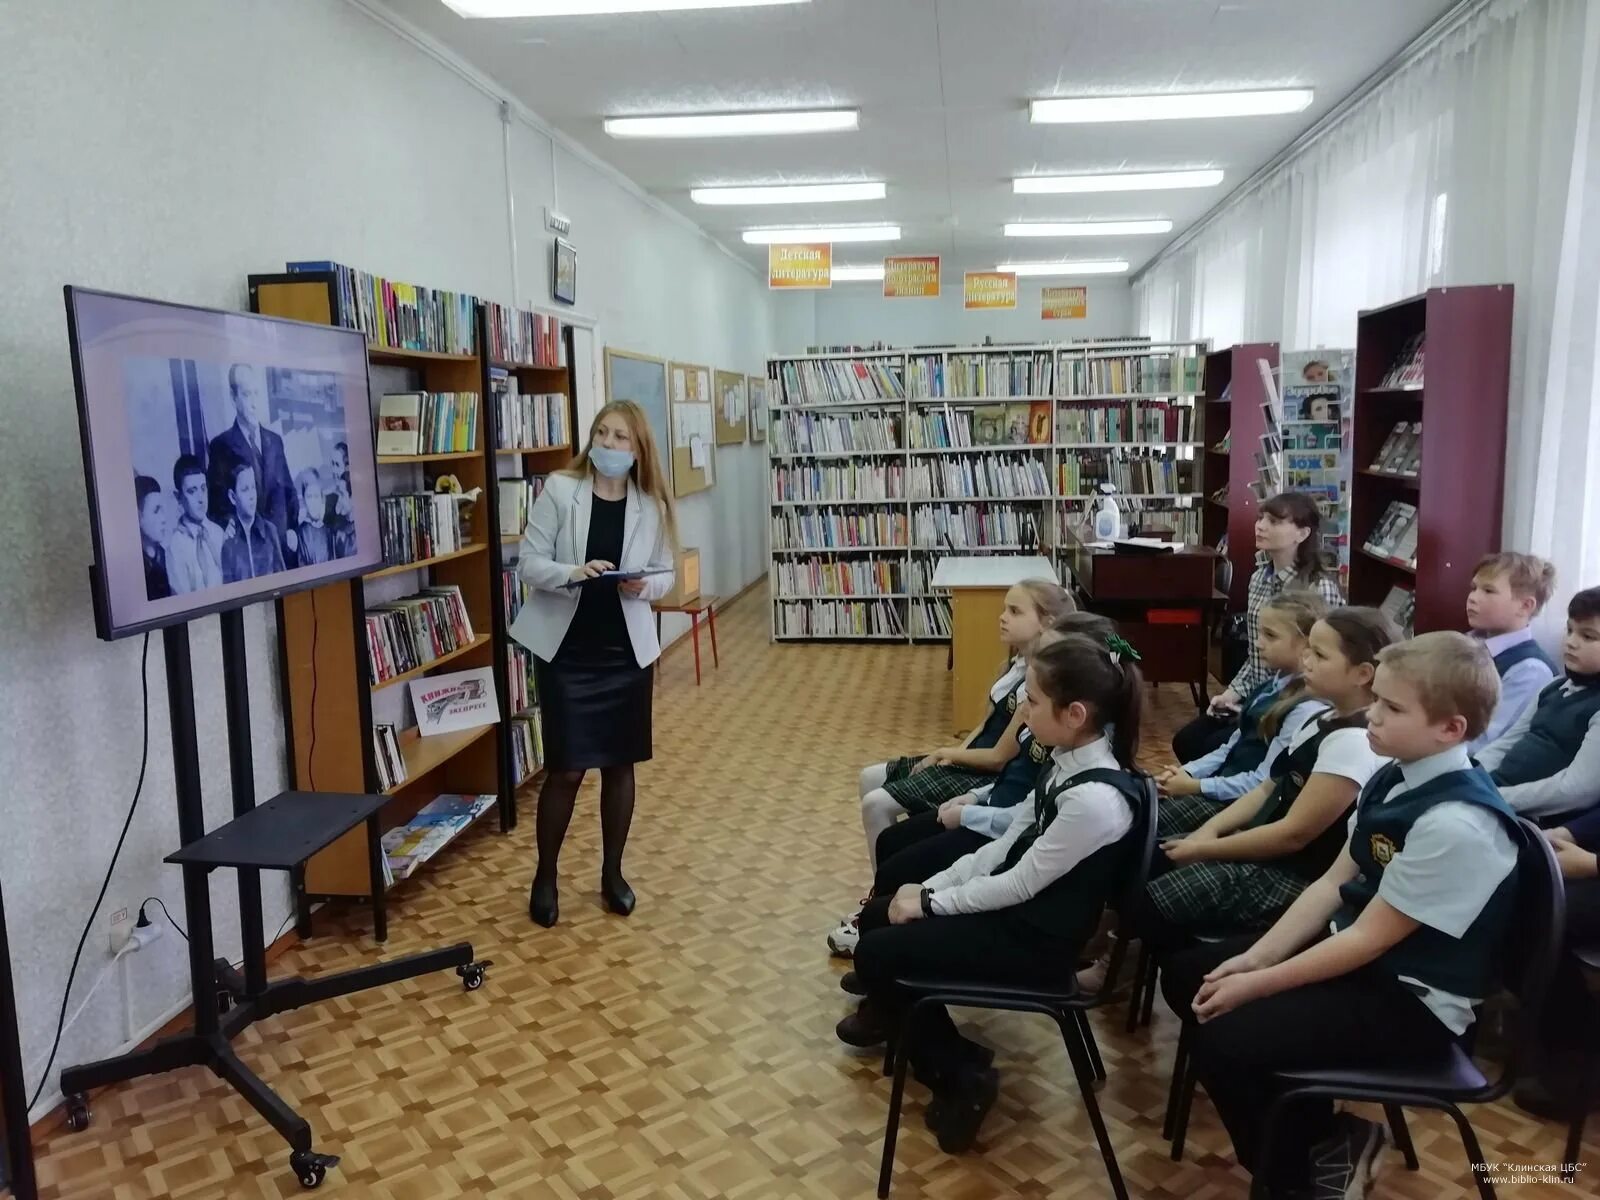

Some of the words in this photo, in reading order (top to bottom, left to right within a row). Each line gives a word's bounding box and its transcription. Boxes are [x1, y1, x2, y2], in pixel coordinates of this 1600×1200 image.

[780, 248, 822, 261] Детская
[973, 277, 1009, 290] Русская
[420, 684, 472, 704] КНИЖН
